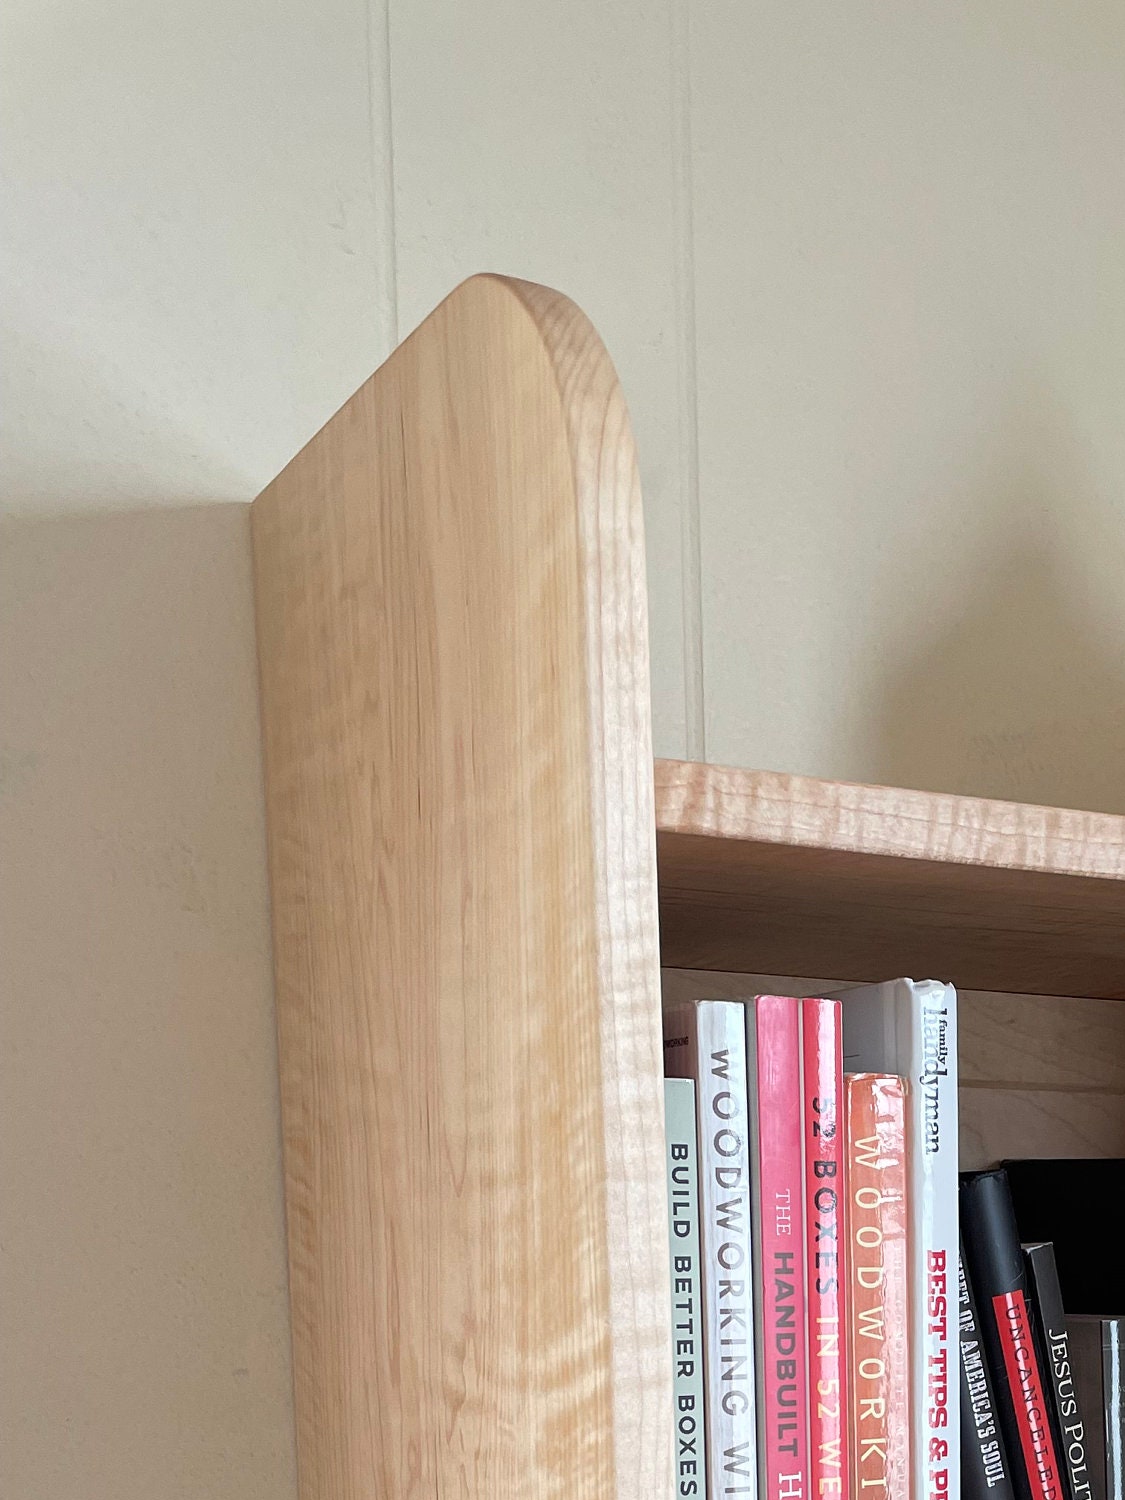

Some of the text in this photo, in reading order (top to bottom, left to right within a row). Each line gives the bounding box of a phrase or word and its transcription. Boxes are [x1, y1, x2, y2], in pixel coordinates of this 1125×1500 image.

[920, 1008, 948, 1155] handyman
[937, 1019, 948, 1066] family
[812, 1097, 836, 1140] 52
[710, 1049, 748, 1416] WOODWORKING
[776, 1189, 791, 1236] THE
[815, 1160, 839, 1295] BOXES
[671, 1143, 698, 1495] BUILD BETTER BOXES
[817, 1316, 839, 1358] IN
[927, 1250, 948, 1340] BEST
[774, 1252, 799, 1457] HANDBUILT
[928, 1349, 949, 1428] TIPS
[1049, 1329, 1077, 1417] JESUS
[817, 1378, 840, 1420] 52
[960, 1340, 997, 1439] AMERICA'S
[980, 1440, 1006, 1488] SOUL
[928, 1436, 949, 1462] &
